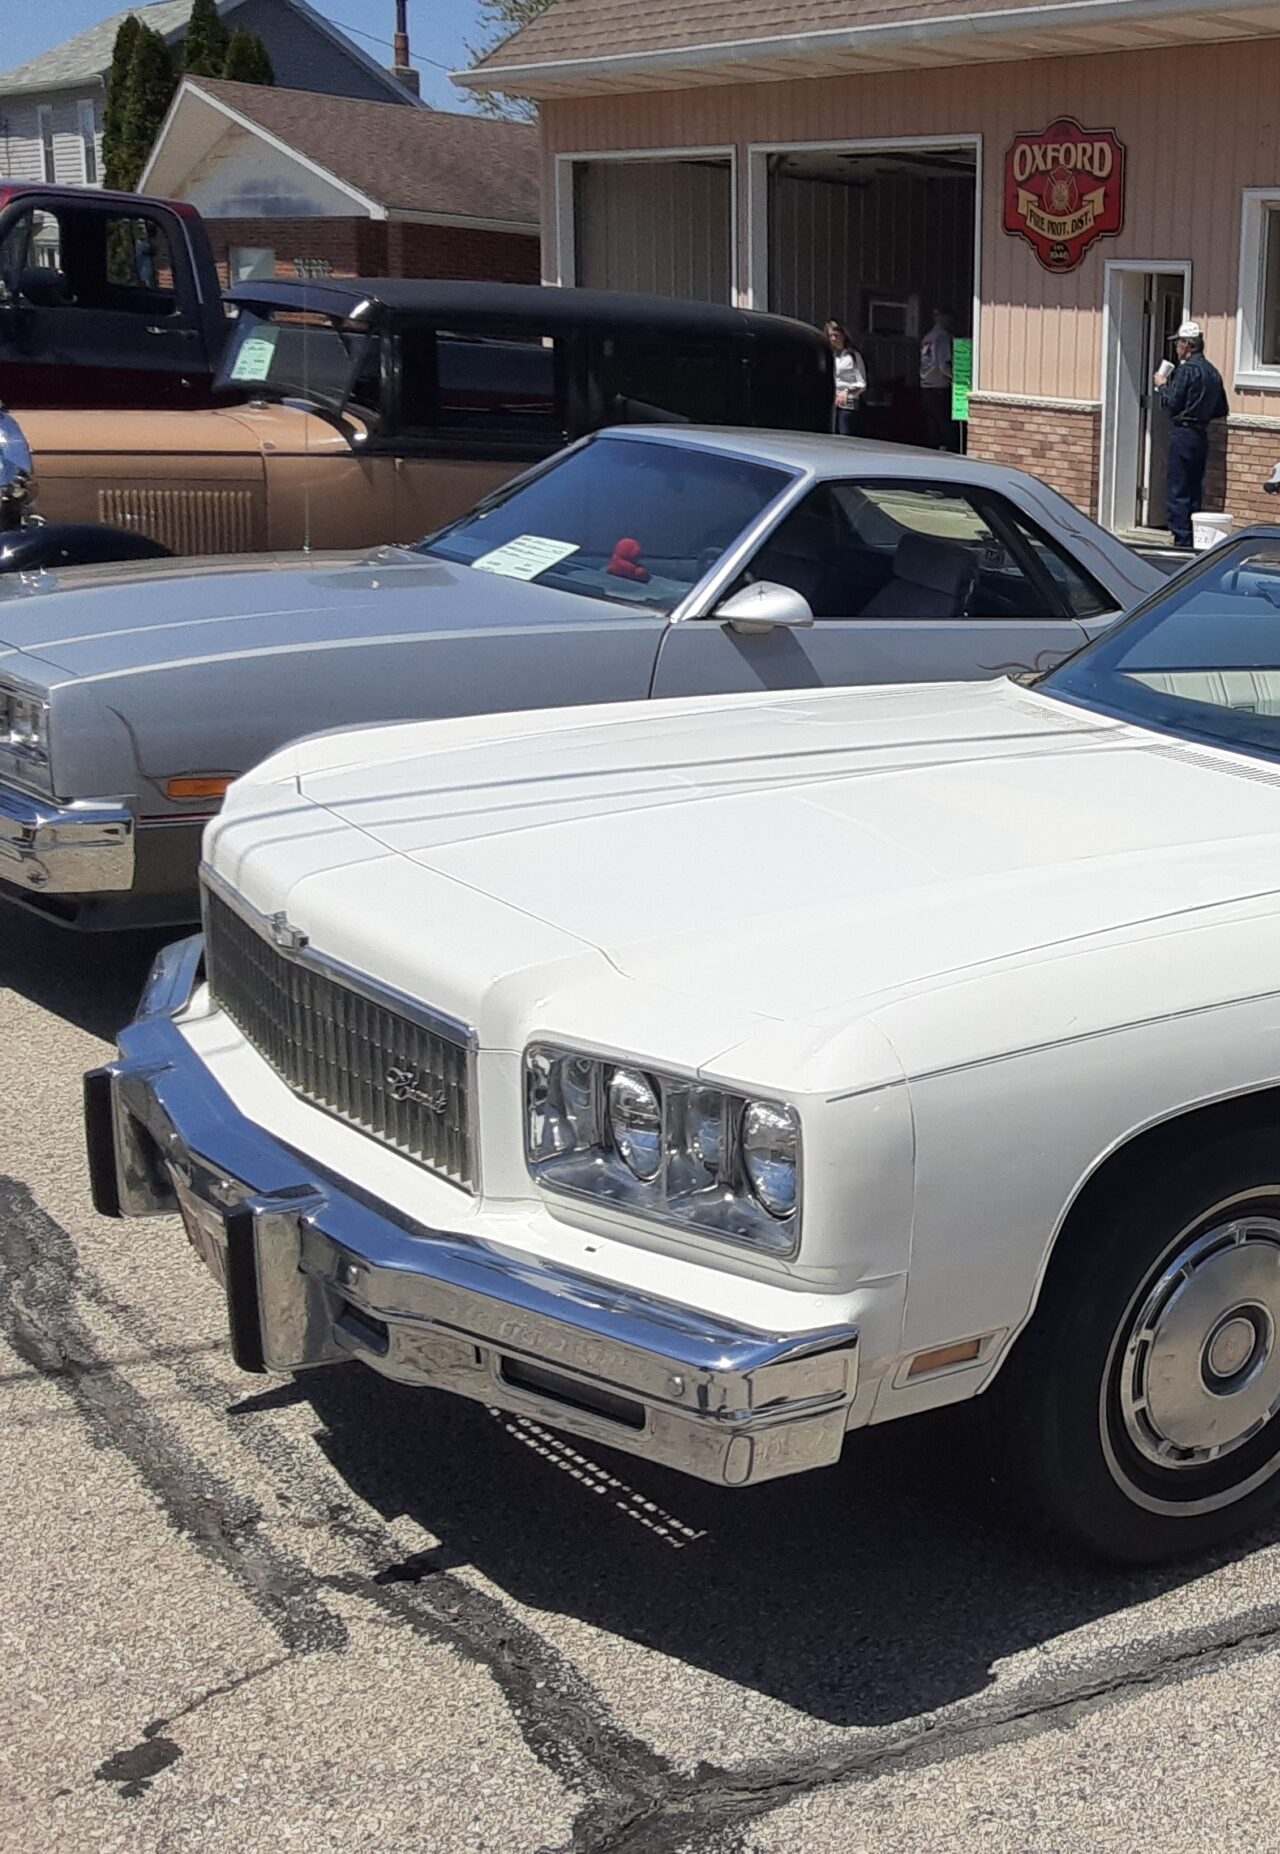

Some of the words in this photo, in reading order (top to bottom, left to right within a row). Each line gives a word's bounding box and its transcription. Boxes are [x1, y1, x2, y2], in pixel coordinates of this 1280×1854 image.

[1013, 142, 1112, 181] OXFORD
[1030, 209, 1046, 231] FIRE
[1047, 219, 1070, 236] PROT.
[1072, 211, 1092, 232] DIST.
